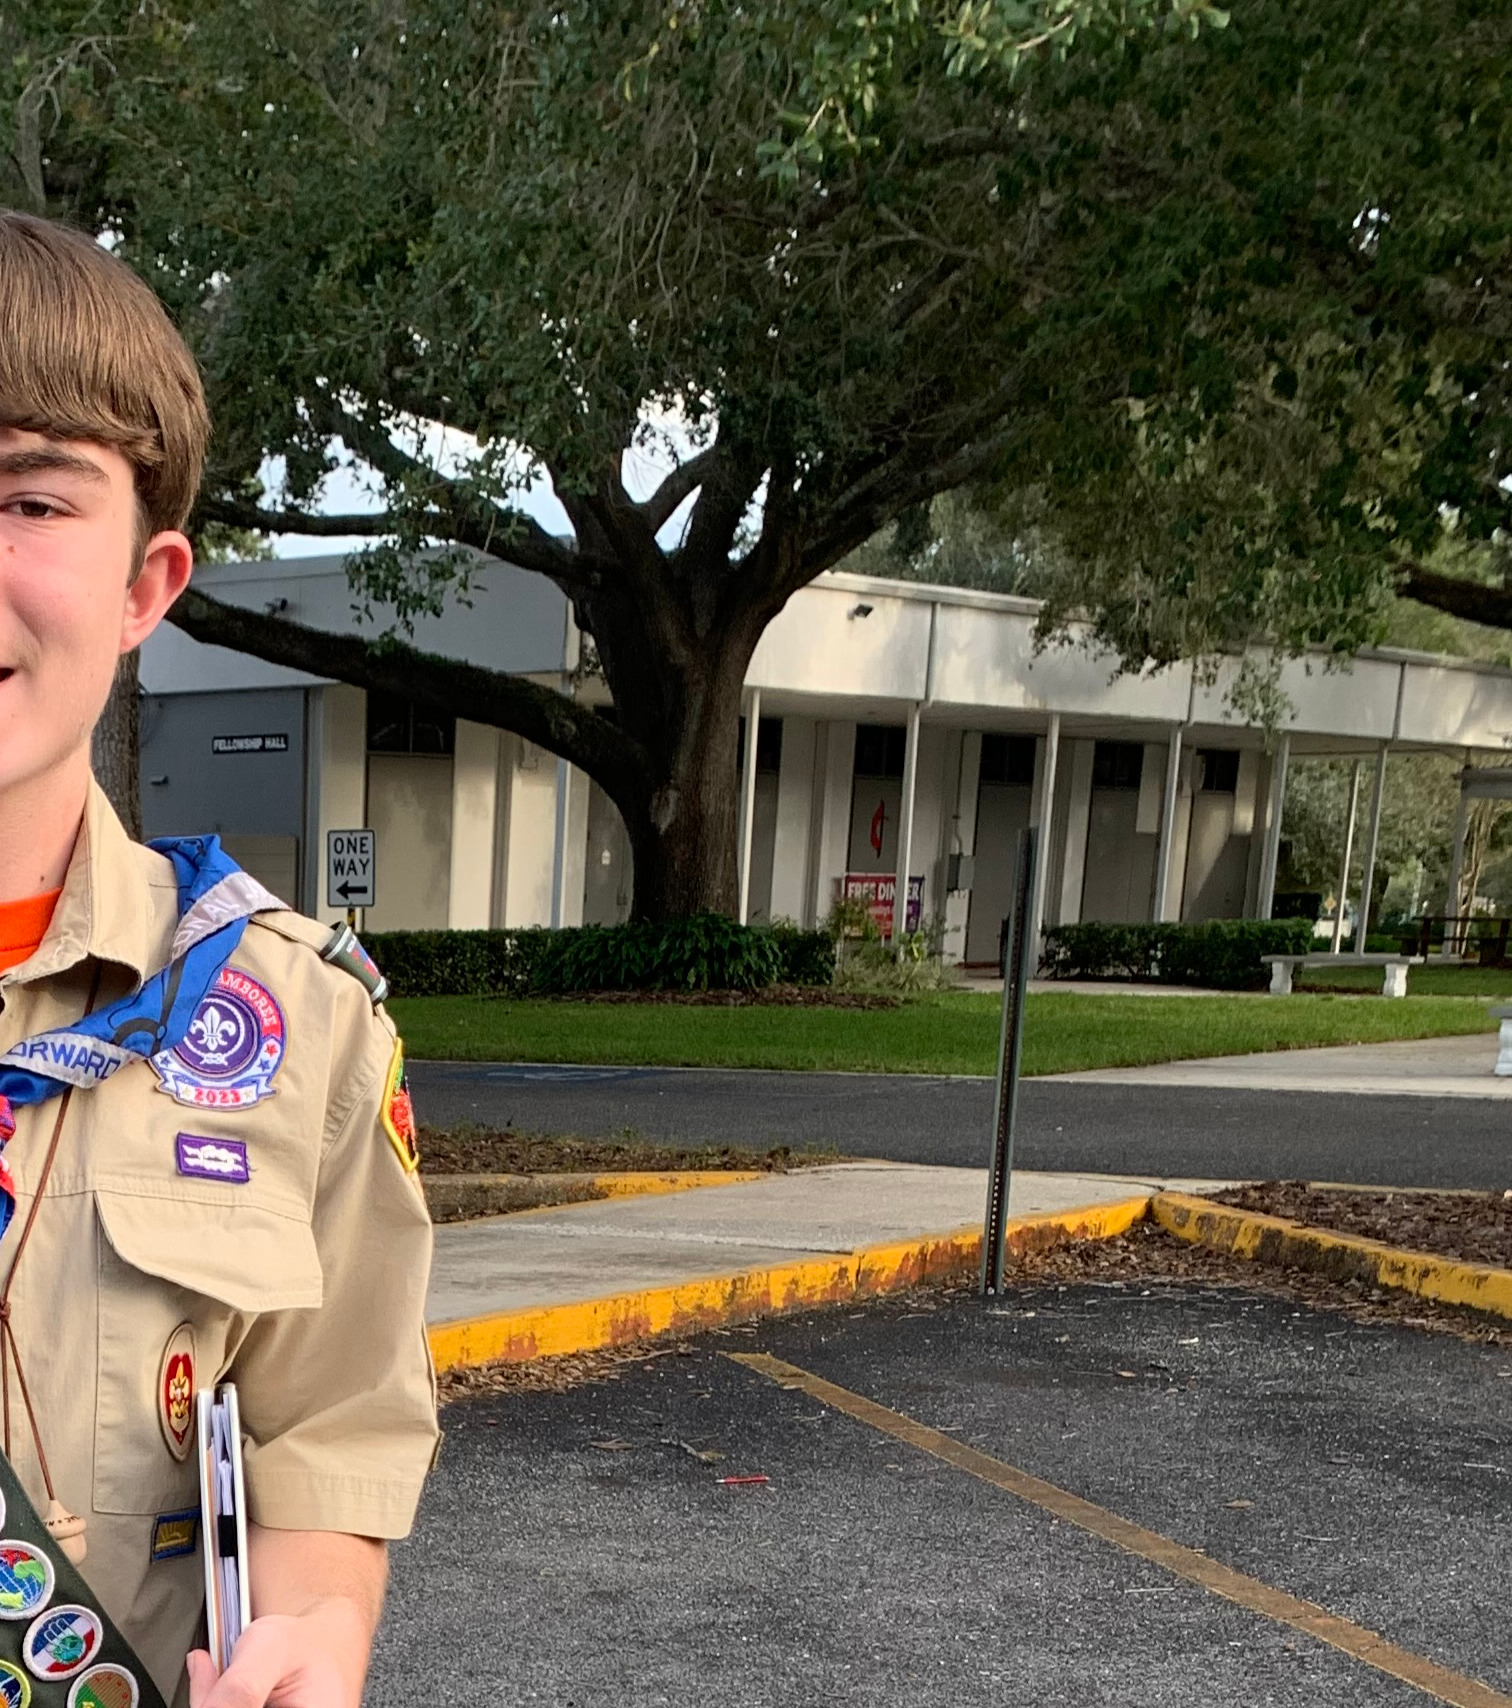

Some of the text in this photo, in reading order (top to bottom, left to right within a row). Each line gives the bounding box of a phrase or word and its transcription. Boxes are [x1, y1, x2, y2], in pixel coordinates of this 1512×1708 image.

[213, 736, 286, 751] FELLOWSHIP HALL
[333, 836, 369, 855] ONE
[333, 858, 370, 876] WAY
[848, 882, 919, 901] FREE DINER
[216, 971, 278, 1027] AMBOREE
[7, 1041, 121, 1080] ORWARD
[193, 1086, 242, 1104] 2023
